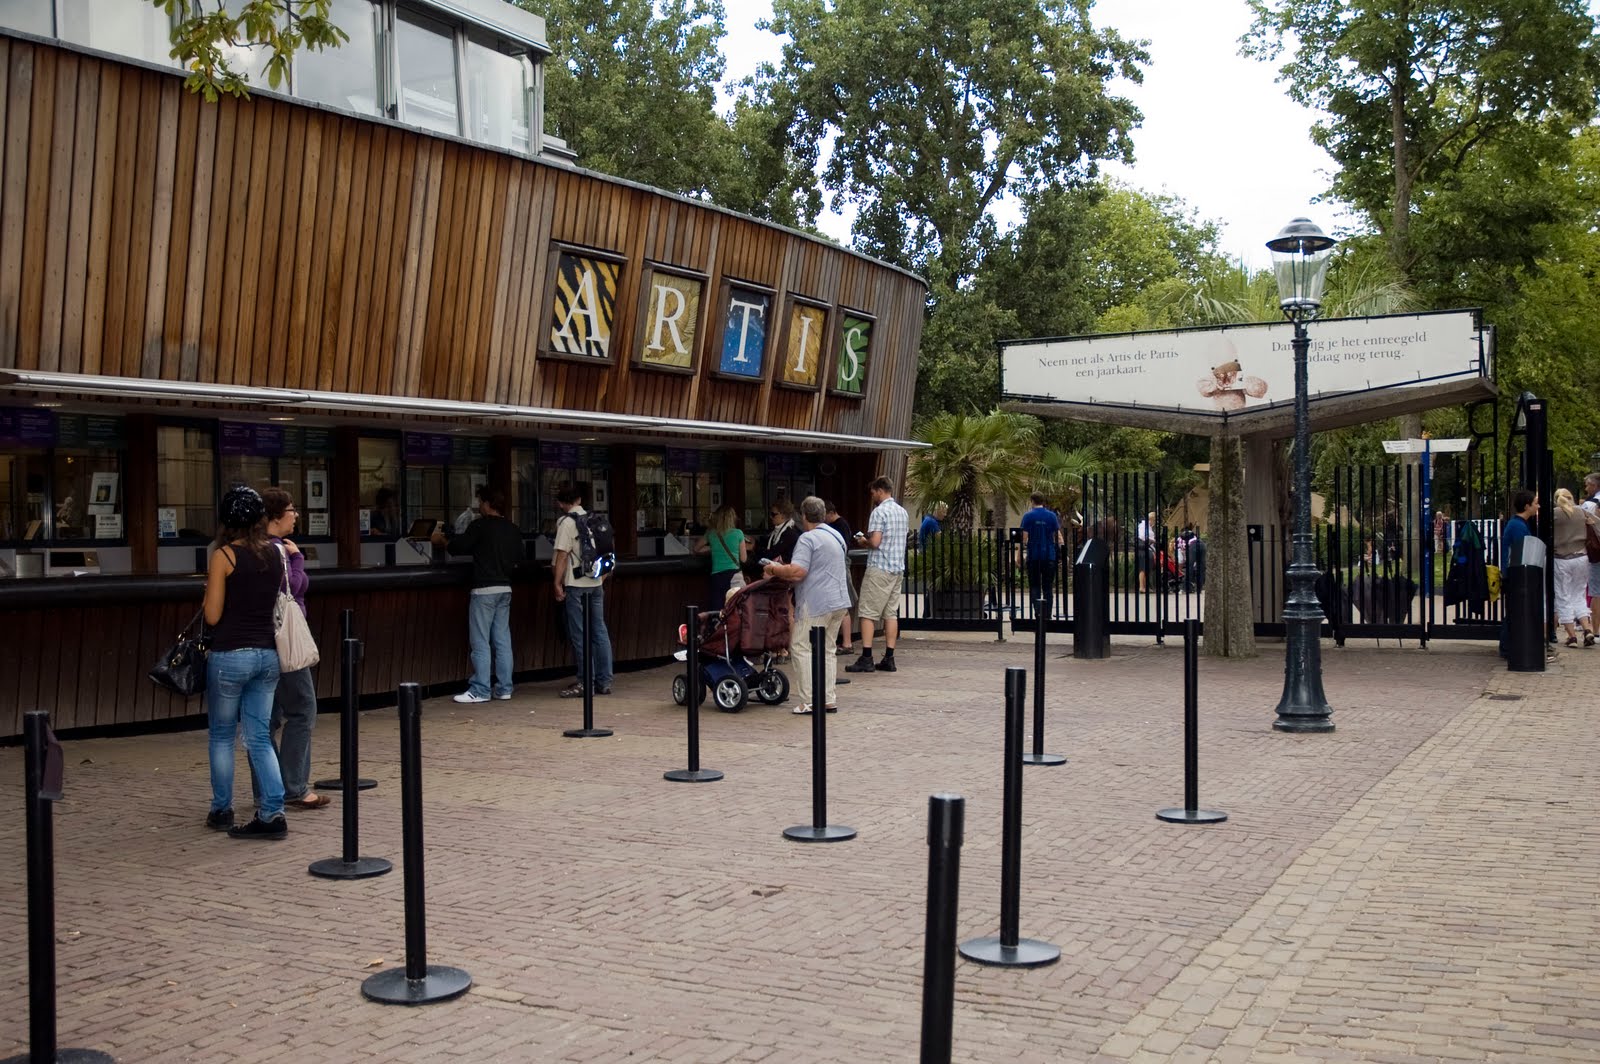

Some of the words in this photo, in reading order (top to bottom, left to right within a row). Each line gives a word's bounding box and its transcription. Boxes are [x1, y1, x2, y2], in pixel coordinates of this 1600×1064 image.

[555, 270, 861, 382] ARTIS
[1326, 337, 1338, 352] je
[1341, 336, 1360, 347] het
[1363, 331, 1427, 347] entreegeld
[1039, 357, 1068, 368] Neem
[1071, 356, 1087, 365] net
[1090, 353, 1104, 364] als
[1107, 352, 1131, 362] Artis
[1134, 350, 1147, 360] de
[1150, 347, 1179, 359] Partis
[1344, 351, 1366, 363] nog
[1369, 349, 1405, 361] terug.
[1075, 369, 1094, 378] een
[1096, 364, 1147, 379] jaarkaart.
